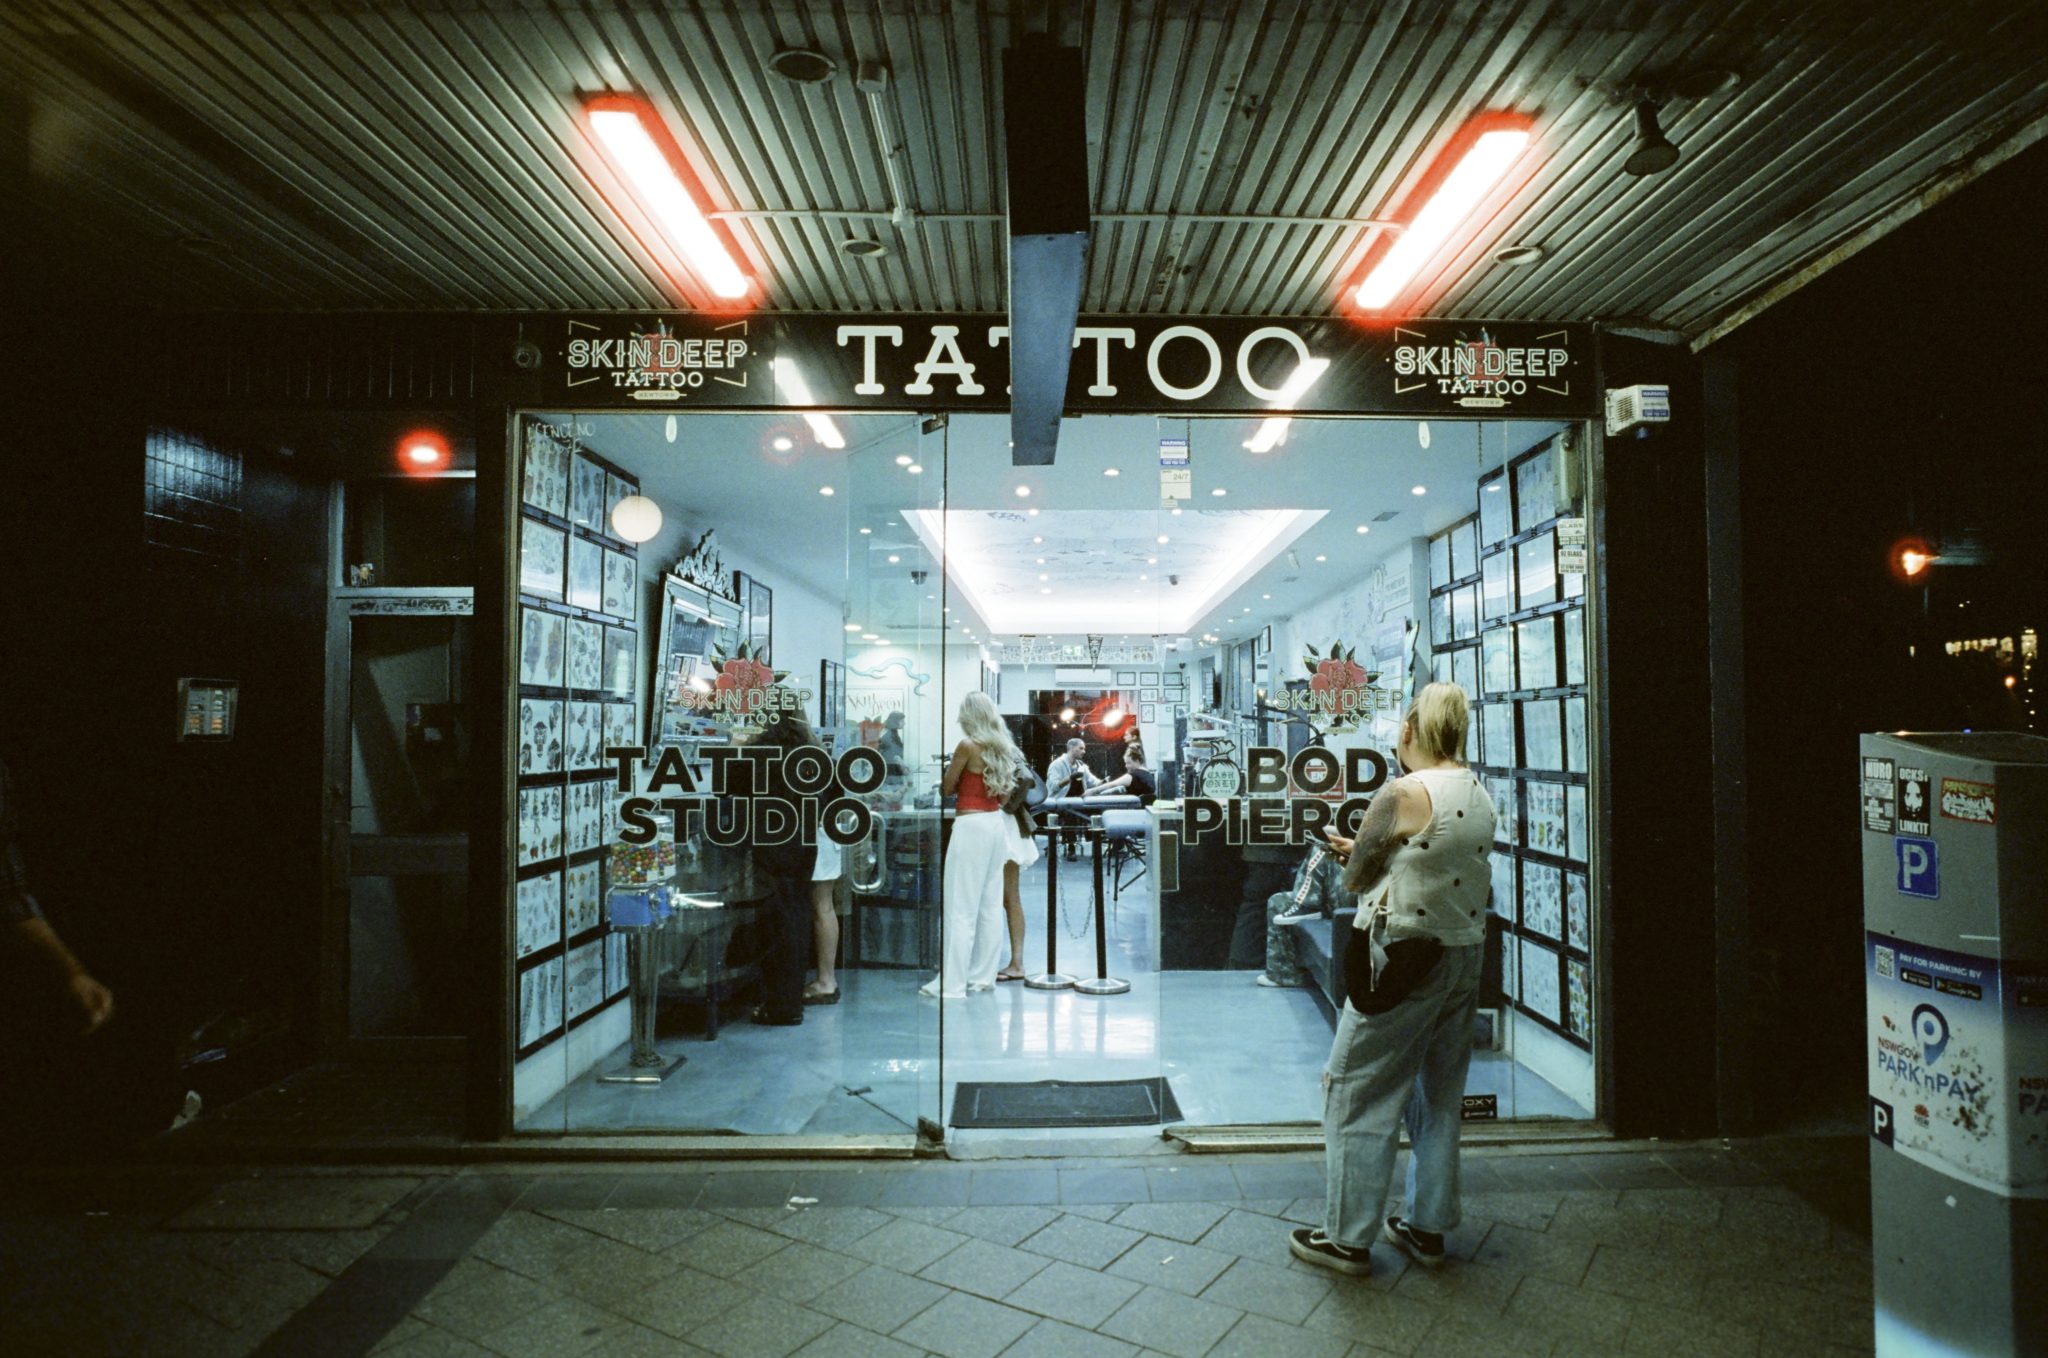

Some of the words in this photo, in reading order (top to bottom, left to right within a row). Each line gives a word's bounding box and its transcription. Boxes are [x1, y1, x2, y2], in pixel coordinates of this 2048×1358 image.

[568, 339, 651, 368] SKIN
[659, 339, 748, 368] DEEP
[1395, 346, 1477, 376] SKIN
[1483, 348, 1568, 377] DEEP
[611, 372, 704, 387] TATTOO
[1437, 379, 1527, 395] TATTOO
[1173, 472, 1189, 481] 24/7
[679, 688, 741, 710] SKIN
[747, 688, 814, 710] DEEP
[1274, 688, 1336, 711] SKIN
[1341, 689, 1405, 711] DEEP
[712, 713, 780, 725] TATTOO
[1306, 713, 1374, 725] TATTOO
[605, 745, 887, 796] TATTOO
[1247, 746, 1413, 794] BOD
[618, 796, 873, 847] STUDIO
[1903, 844, 1928, 889] P
[1899, 953, 1913, 964] PAY
[1913, 956, 1928, 968] FOR
[1929, 960, 1968, 977] PARKING
[1968, 969, 1982, 979] BY
[1874, 1104, 1888, 1134] P
